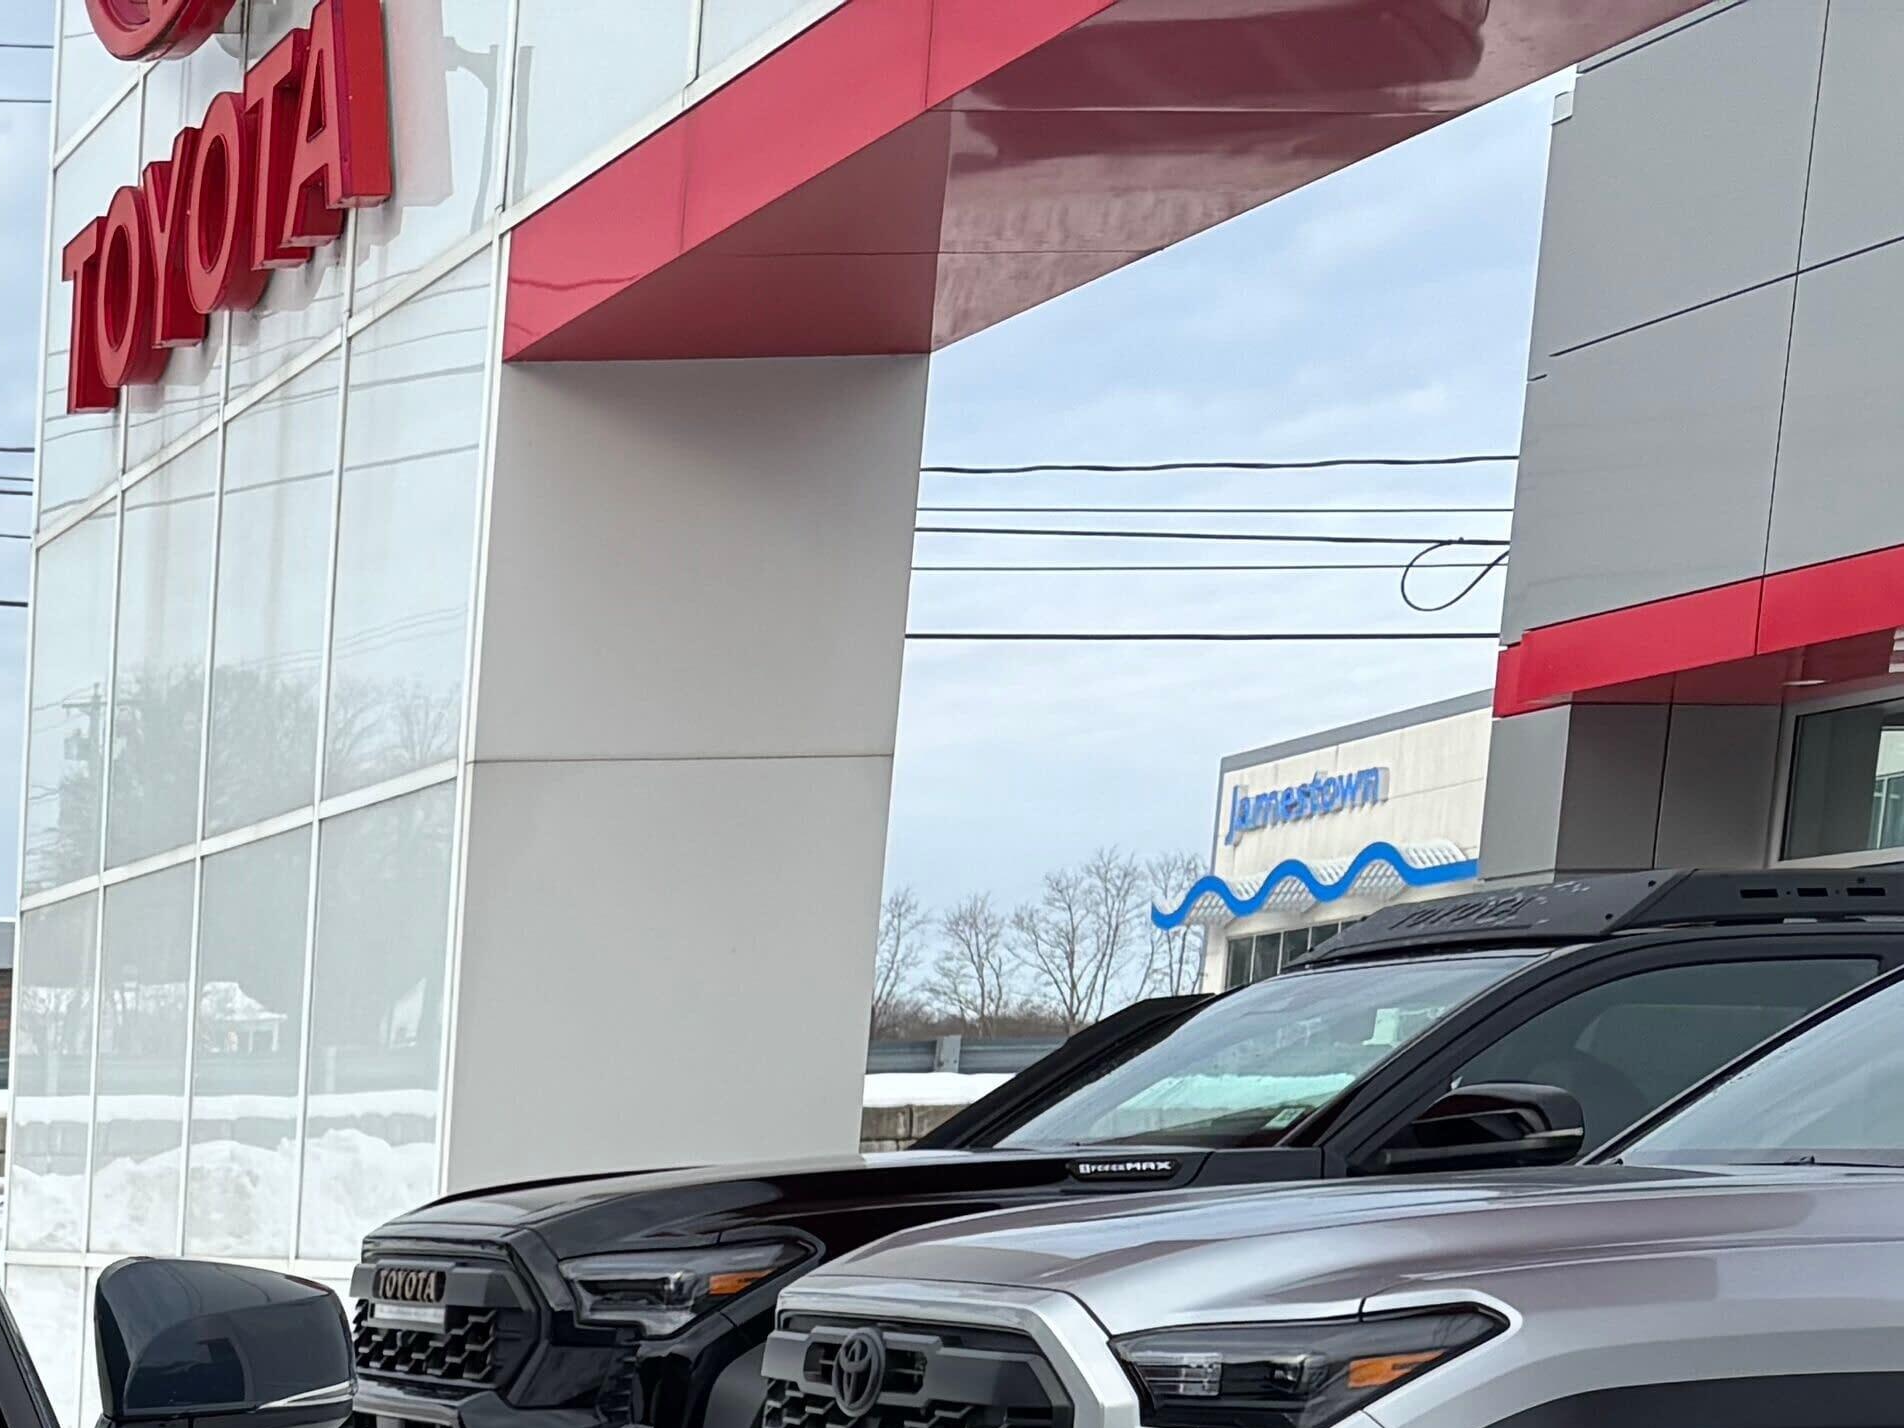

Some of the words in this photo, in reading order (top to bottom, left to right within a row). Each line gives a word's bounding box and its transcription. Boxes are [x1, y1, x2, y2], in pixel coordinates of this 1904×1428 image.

[62, 0, 391, 414] TOYOTA
[1224, 767, 1386, 846] Jamestown
[378, 1269, 437, 1302] TOYOTA
